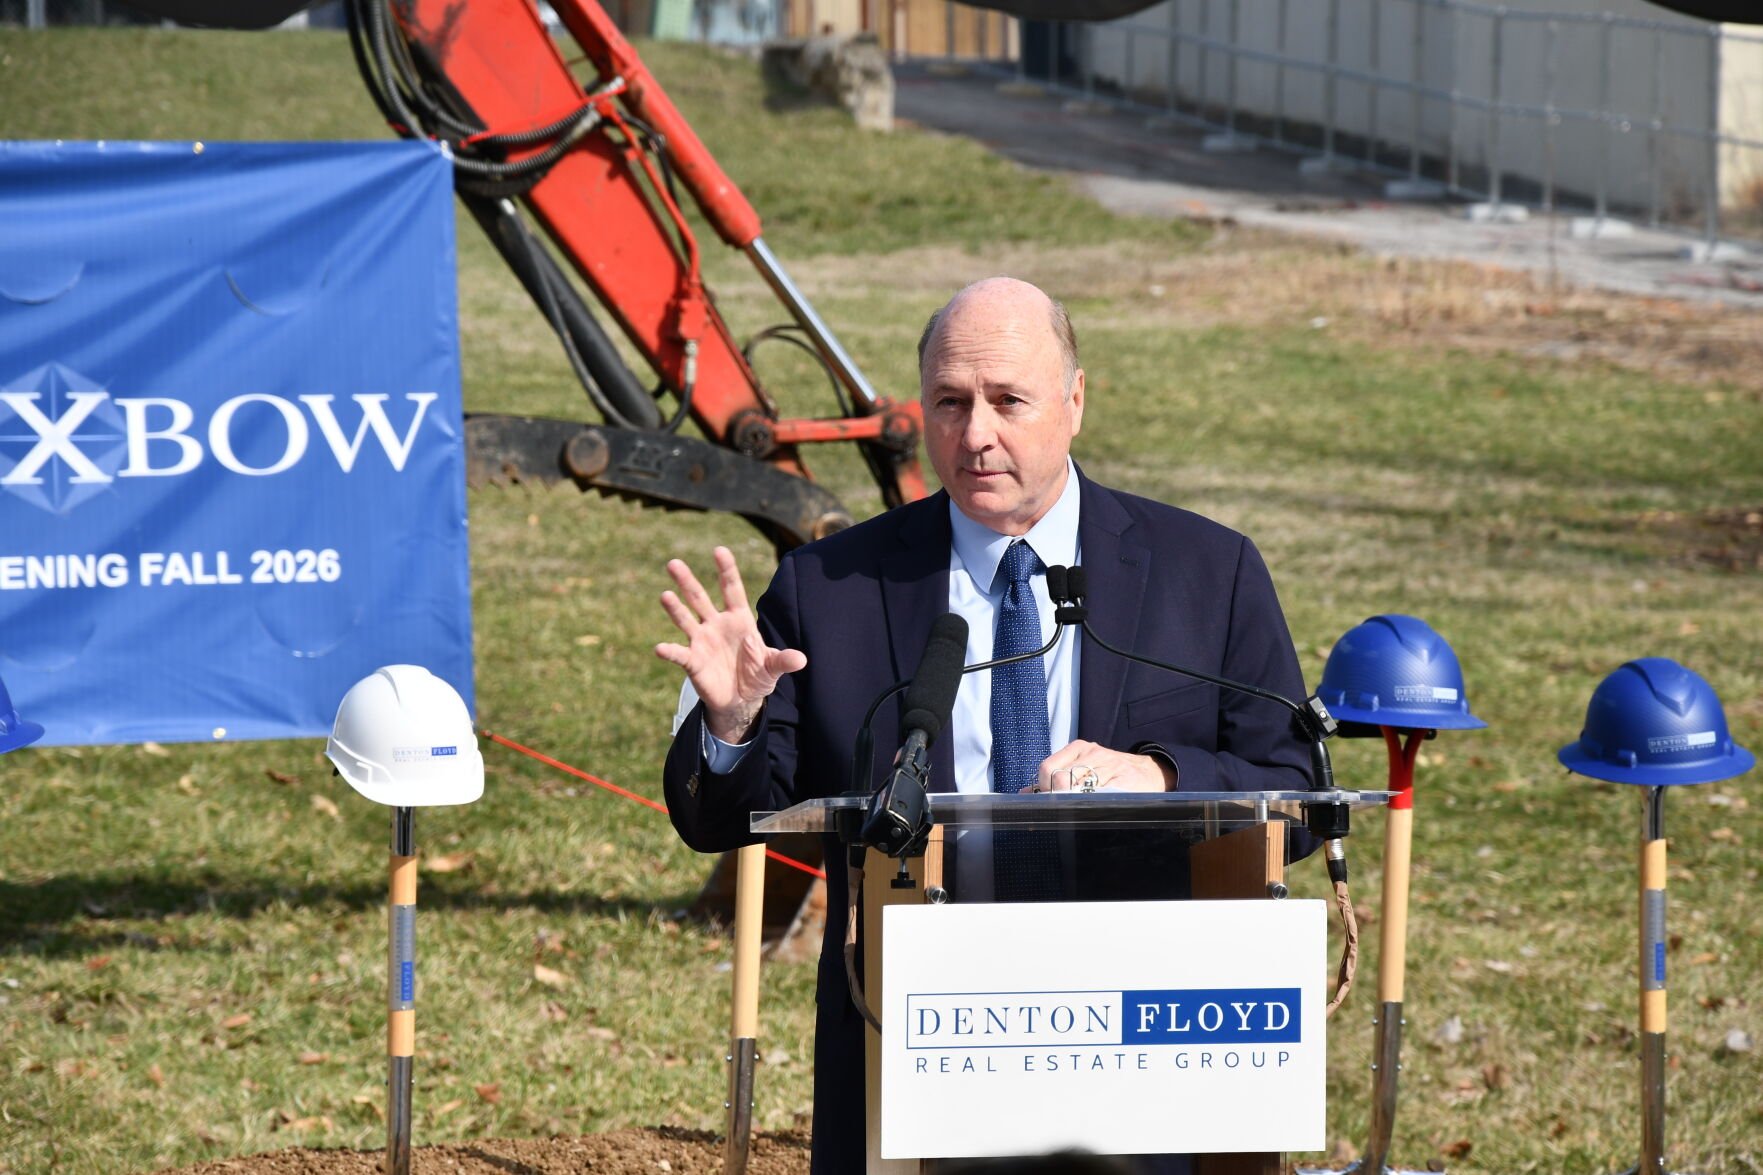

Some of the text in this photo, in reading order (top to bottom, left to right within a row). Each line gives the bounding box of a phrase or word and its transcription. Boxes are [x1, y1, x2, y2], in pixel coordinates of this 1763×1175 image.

[0, 549, 341, 590] ENING FALL 2026
[916, 1002, 1290, 1036] DENTON FLOYD
[916, 1050, 1290, 1074] REAL ESTATE GROUP
